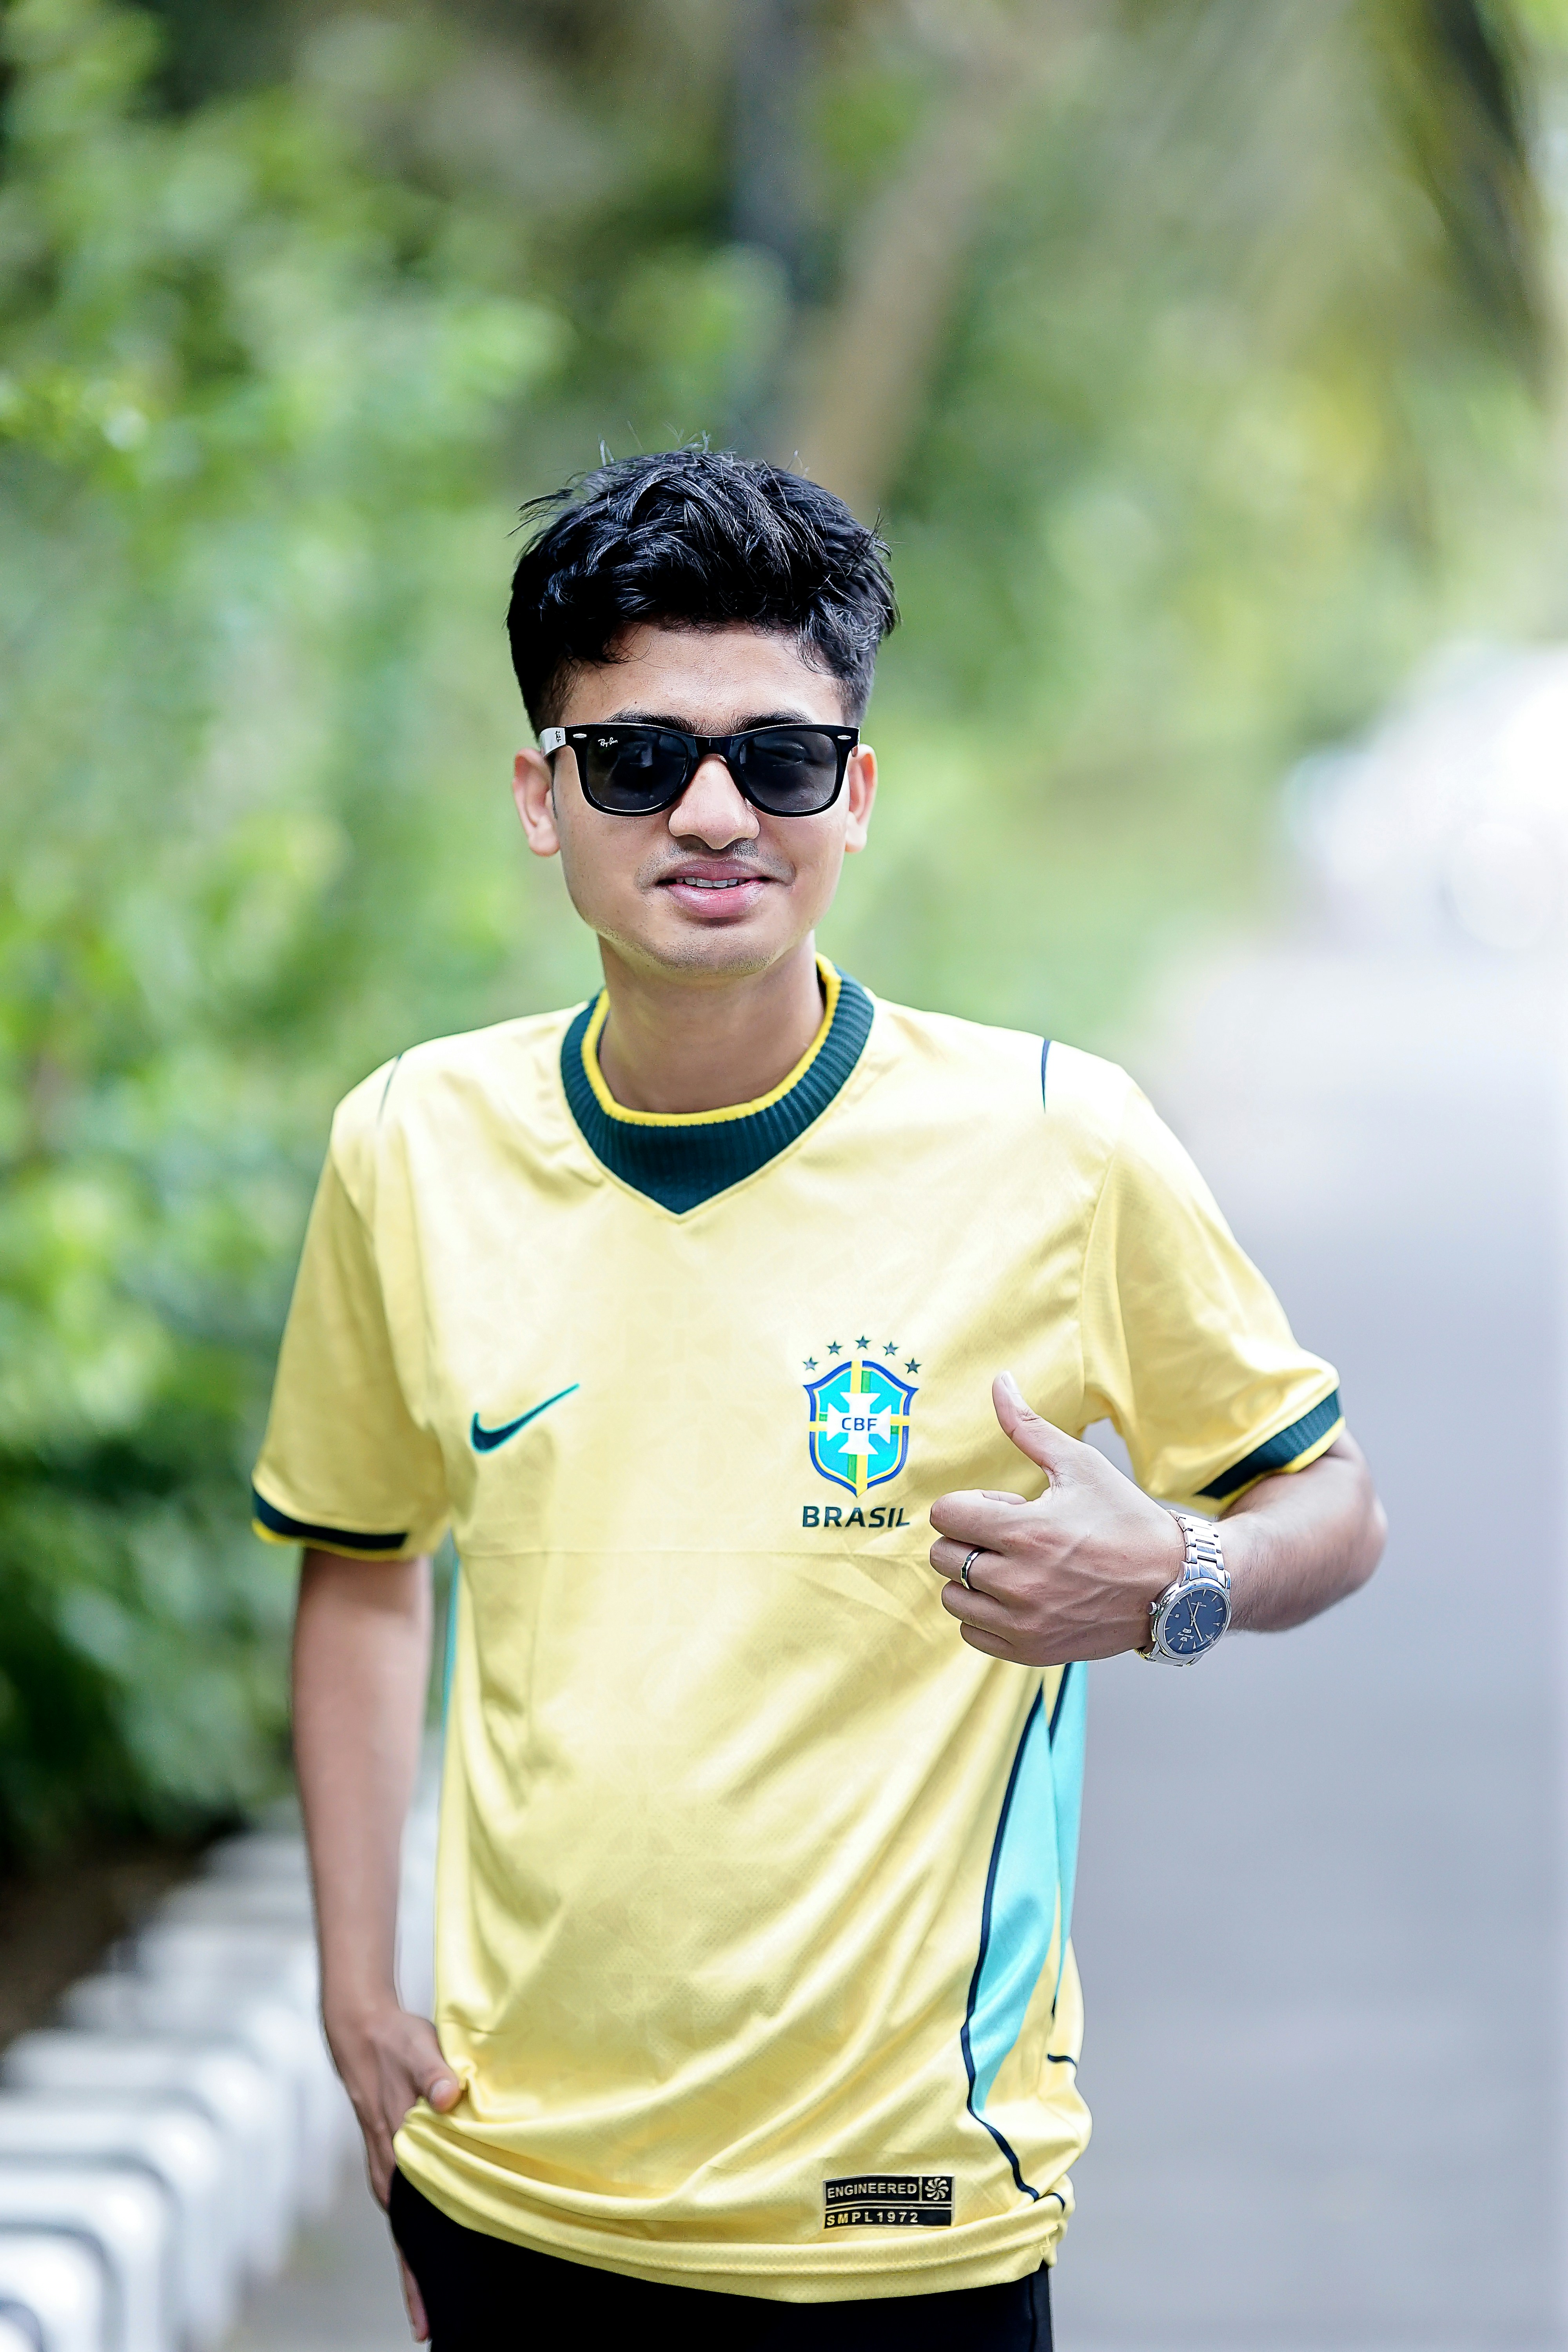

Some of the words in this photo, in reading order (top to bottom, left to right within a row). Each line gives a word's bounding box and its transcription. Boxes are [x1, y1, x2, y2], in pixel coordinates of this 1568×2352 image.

[842, 1417, 877, 1431] CBF
[803, 1506, 909, 1528] BRASIL
[828, 2183, 917, 2198] ENGINEERED
